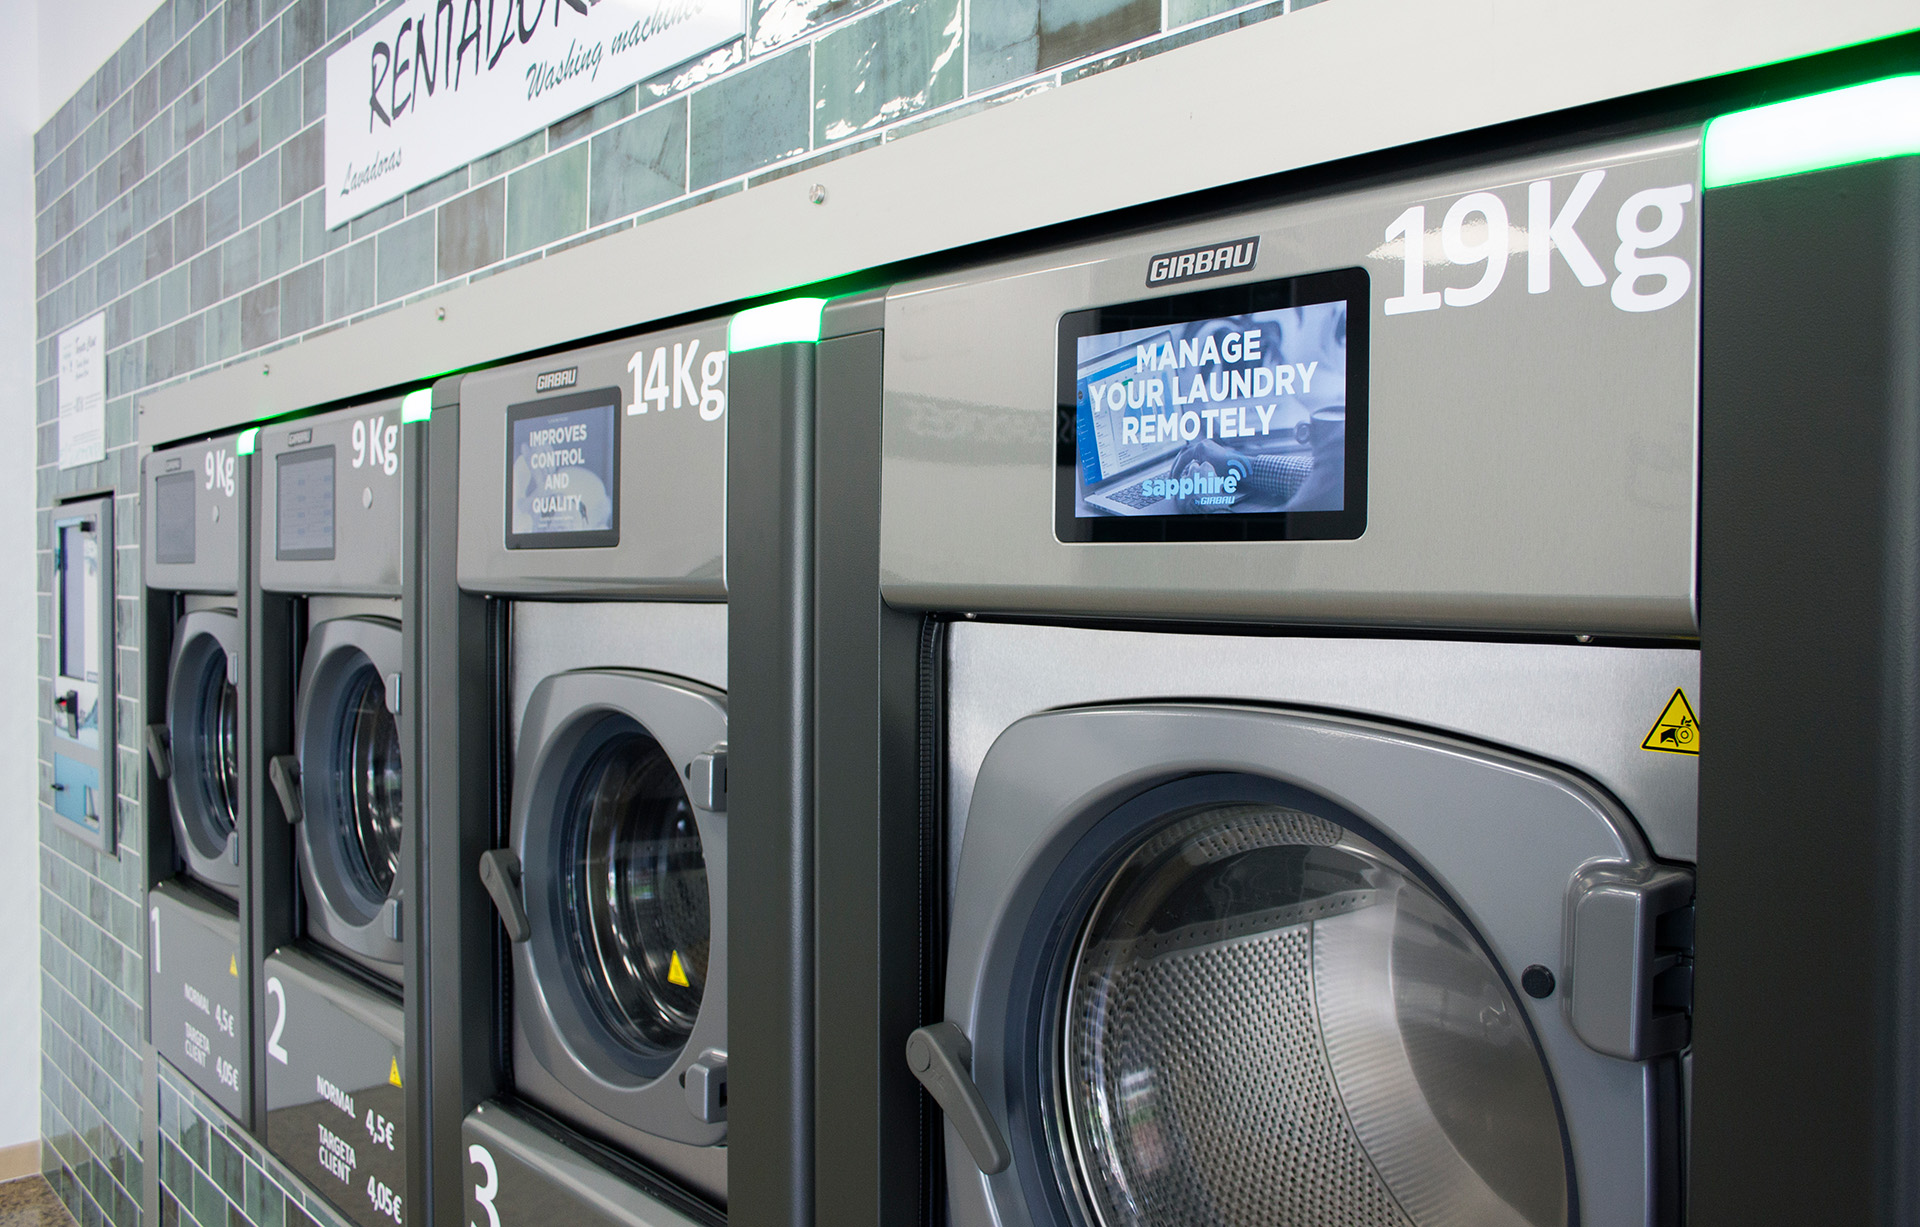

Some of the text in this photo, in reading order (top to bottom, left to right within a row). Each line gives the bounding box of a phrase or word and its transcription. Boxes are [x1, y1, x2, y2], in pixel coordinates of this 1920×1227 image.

[526, 38, 602, 100] Washing
[340, 146, 402, 198] Lavadoras
[1150, 242, 1255, 282] GIRBAU
[1384, 169, 1693, 313] 19Kg
[1136, 329, 1262, 374] MANAGE
[537, 368, 577, 391] GIRBAU
[626, 338, 727, 422] 14Kg
[1089, 361, 1319, 413] YOUR LAUNDRY
[351, 415, 399, 476] 9Kg
[529, 423, 588, 447] IMPROVES
[1122, 404, 1277, 445] REMOTELY
[204, 449, 235, 498] 9Kg
[530, 447, 585, 470] CONTROL
[544, 472, 570, 491] AND
[532, 493, 582, 514] QUALITY
[1141, 471, 1238, 500] sapphire
[1200, 495, 1236, 506] GIRBAU
[150, 905, 162, 974] 1
[184, 982, 235, 1038] NORMAL 4,5€
[266, 976, 289, 1066] 2
[184, 1021, 210, 1055] TARGETA
[184, 1038, 207, 1068] CLIENT
[316, 1074, 395, 1151] NORMAL 4,5€
[317, 1123, 357, 1169] TARGETA
[318, 1144, 403, 1225] CLIENT 4,05€
[469, 1144, 501, 1227] 3
